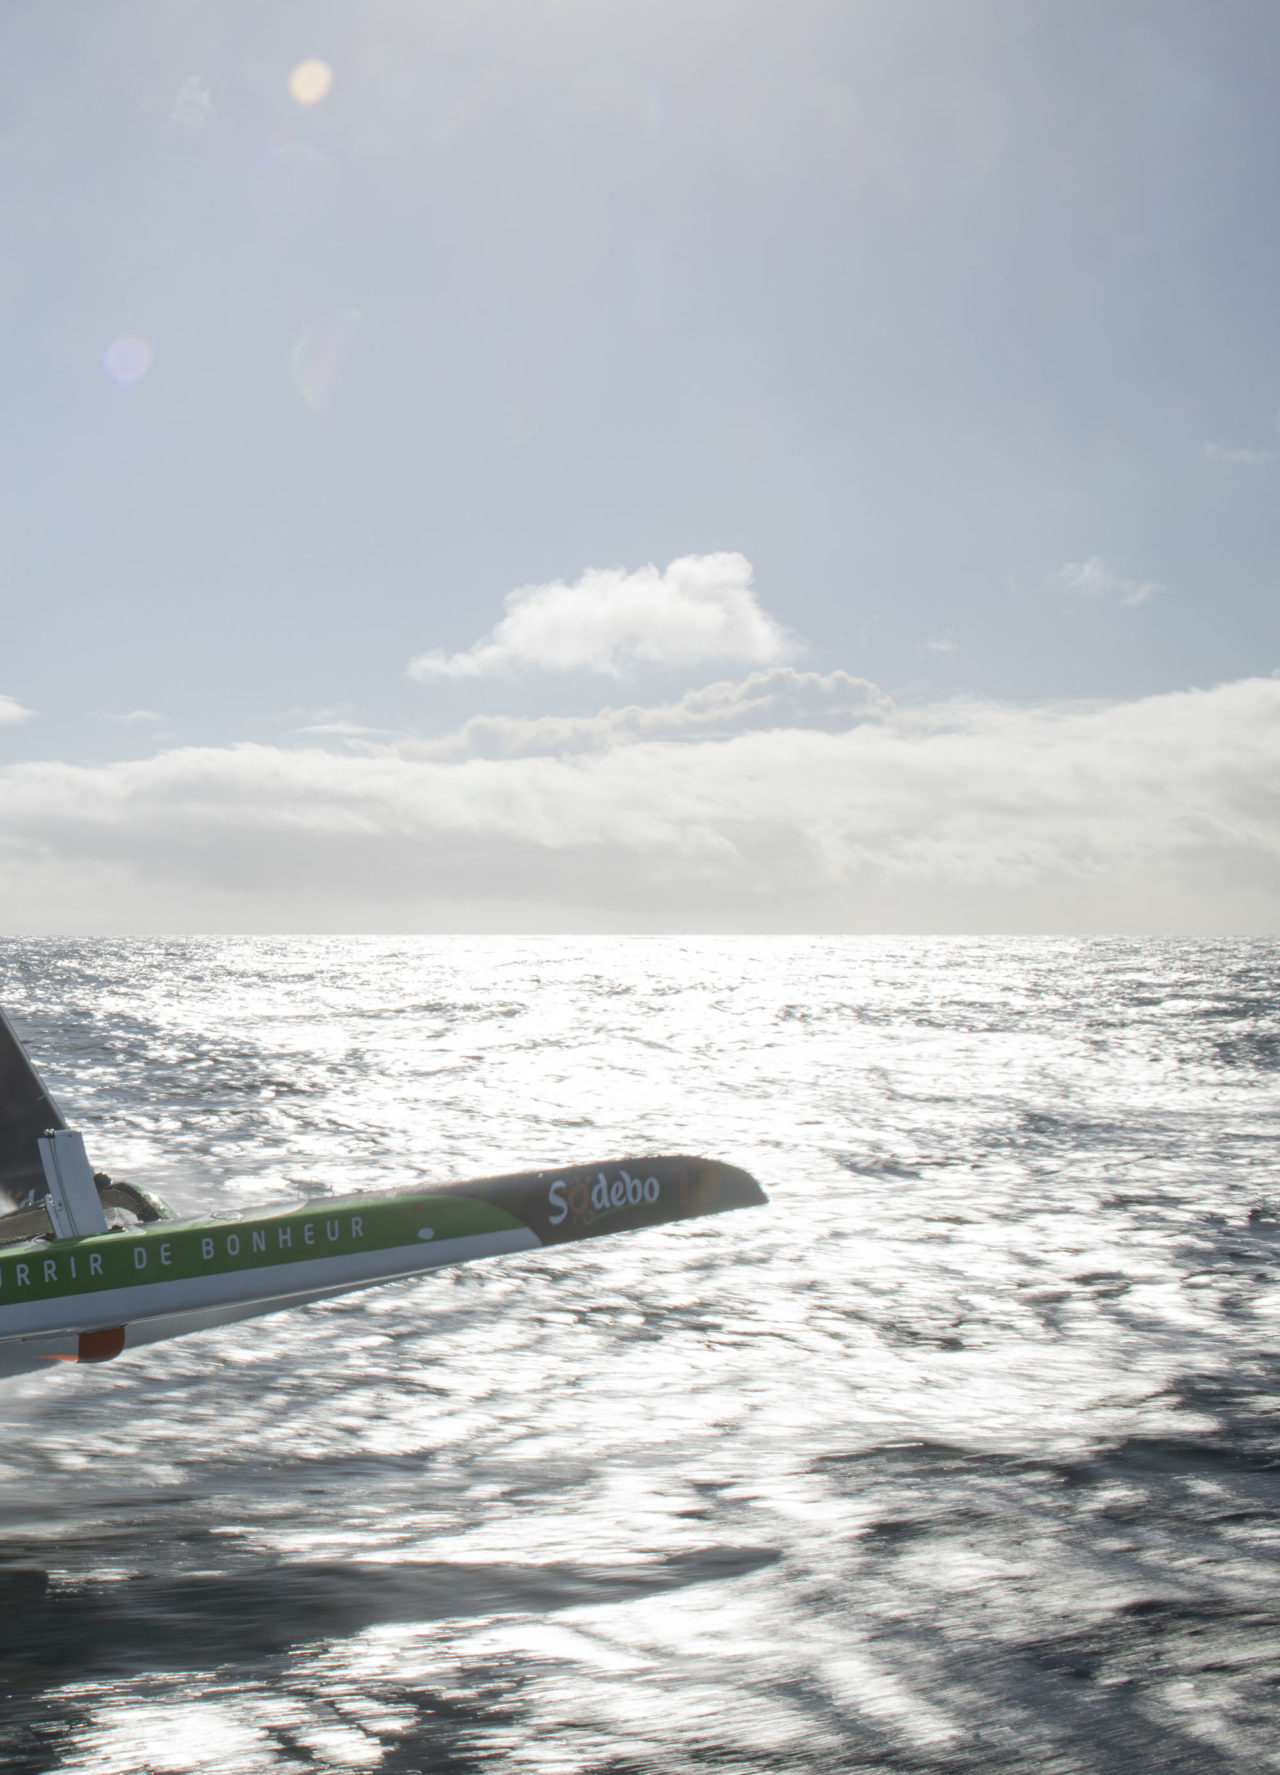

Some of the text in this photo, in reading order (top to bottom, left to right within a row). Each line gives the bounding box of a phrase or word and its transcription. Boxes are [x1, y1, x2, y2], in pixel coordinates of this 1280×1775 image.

[548, 1169, 660, 1225] Sodebo
[134, 1243, 173, 1270] DE
[202, 1216, 364, 1260] BONHEUR
